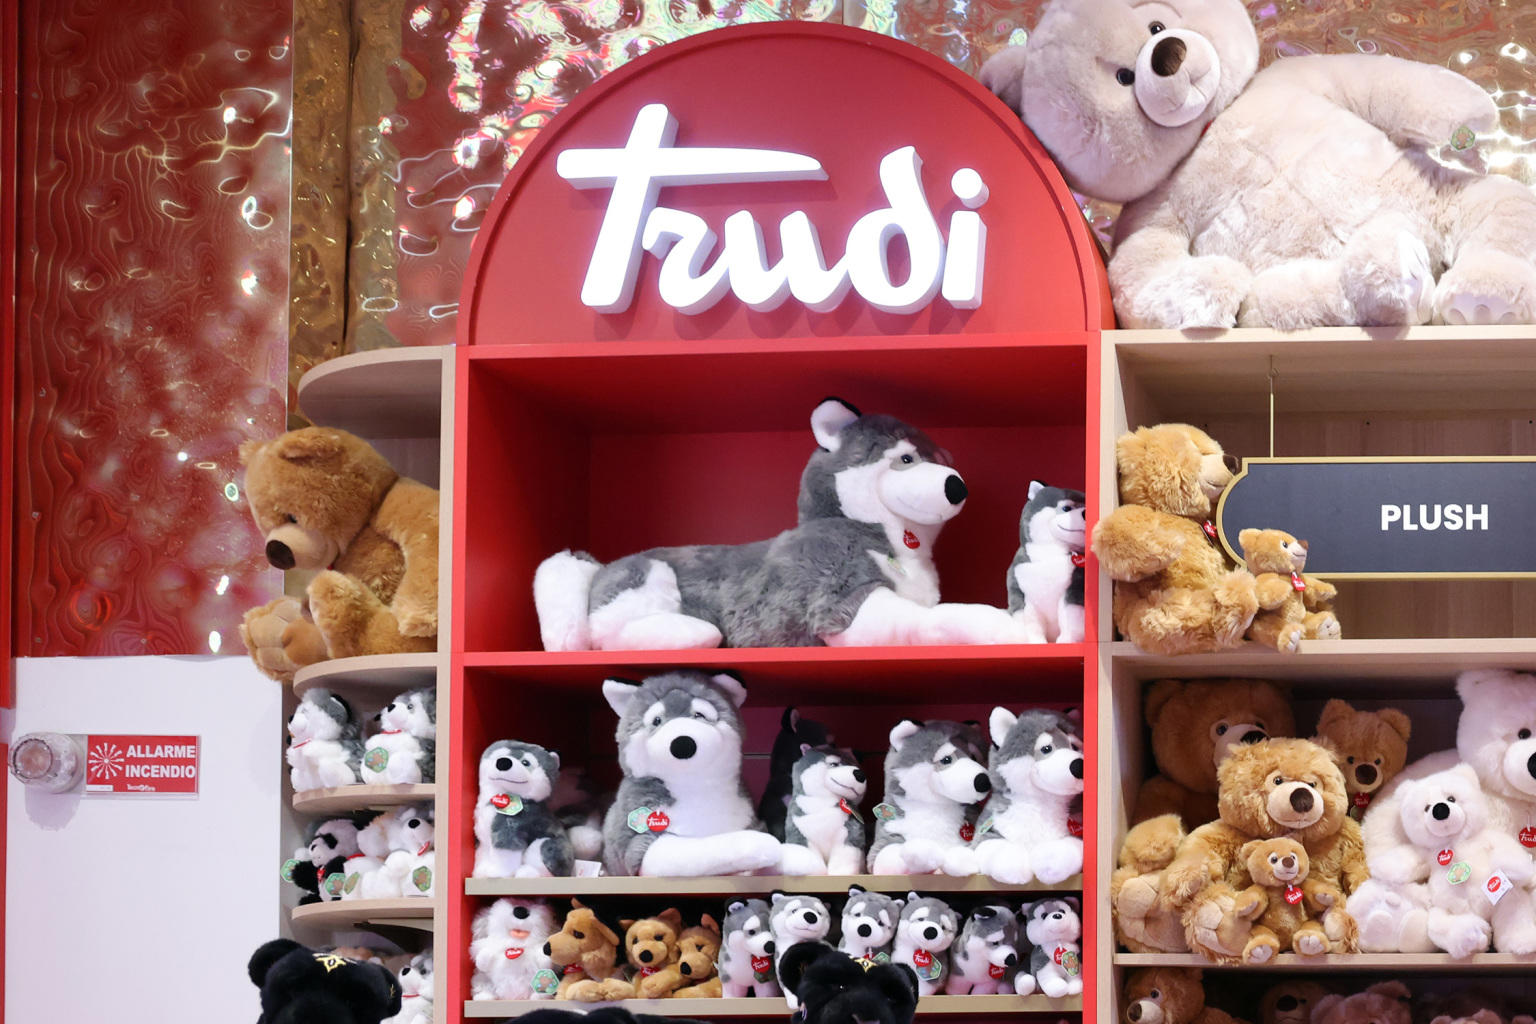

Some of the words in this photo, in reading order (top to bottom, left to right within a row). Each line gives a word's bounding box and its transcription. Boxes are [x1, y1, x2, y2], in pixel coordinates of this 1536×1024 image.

[556, 104, 989, 316] Trudi
[1381, 504, 1489, 531] PLUSH
[126, 745, 196, 758] ALLARME
[125, 765, 196, 778] INCENDIO
[649, 816, 668, 826] Trudi
